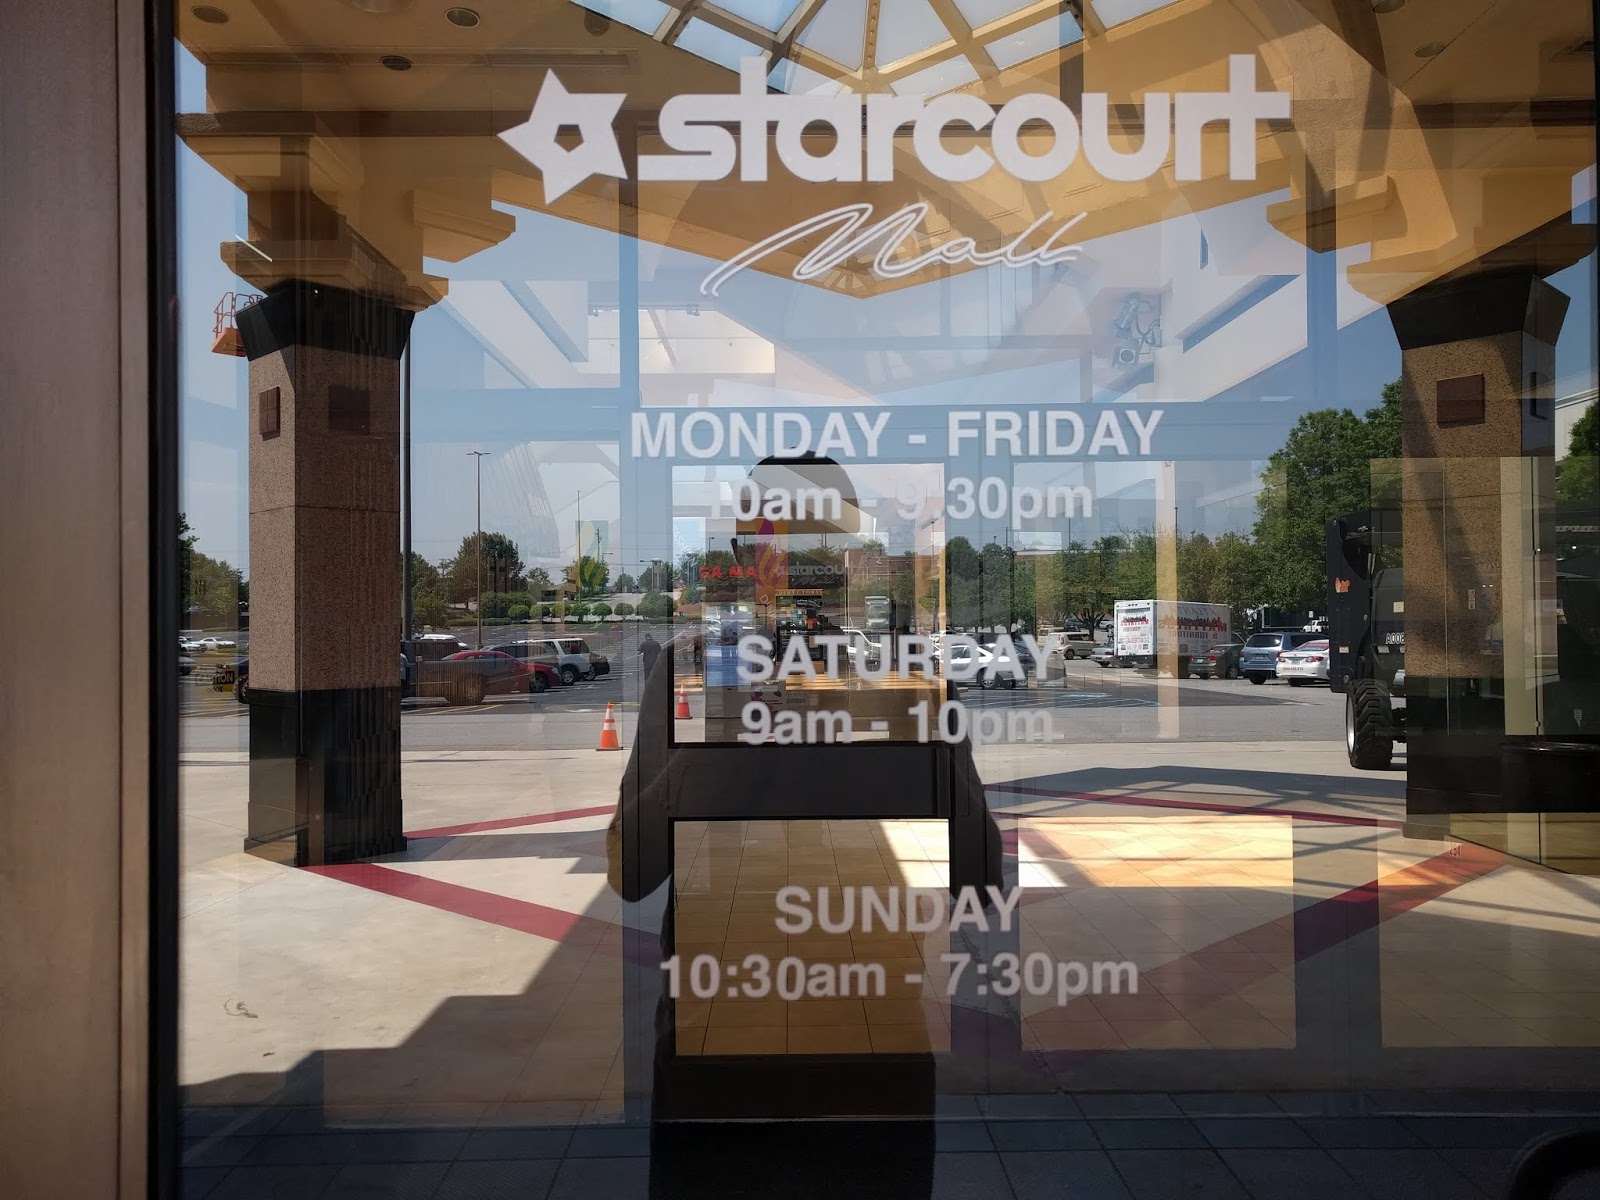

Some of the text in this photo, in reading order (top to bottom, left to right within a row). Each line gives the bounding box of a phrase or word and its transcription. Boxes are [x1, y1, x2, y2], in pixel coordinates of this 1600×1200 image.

[637, 54, 1291, 182] starcourt
[699, 202, 1085, 298] Mall
[630, 411, 892, 459] MONDAY
[948, 409, 1164, 457] FRIDAY
[736, 634, 1059, 681] SATURDAY
[741, 700, 853, 746] 9am
[907, 700, 1054, 755] 10pm
[774, 884, 1025, 934] SUNDAY
[659, 953, 887, 1001] 10:30am
[939, 952, 1140, 1007] 7:30pm
